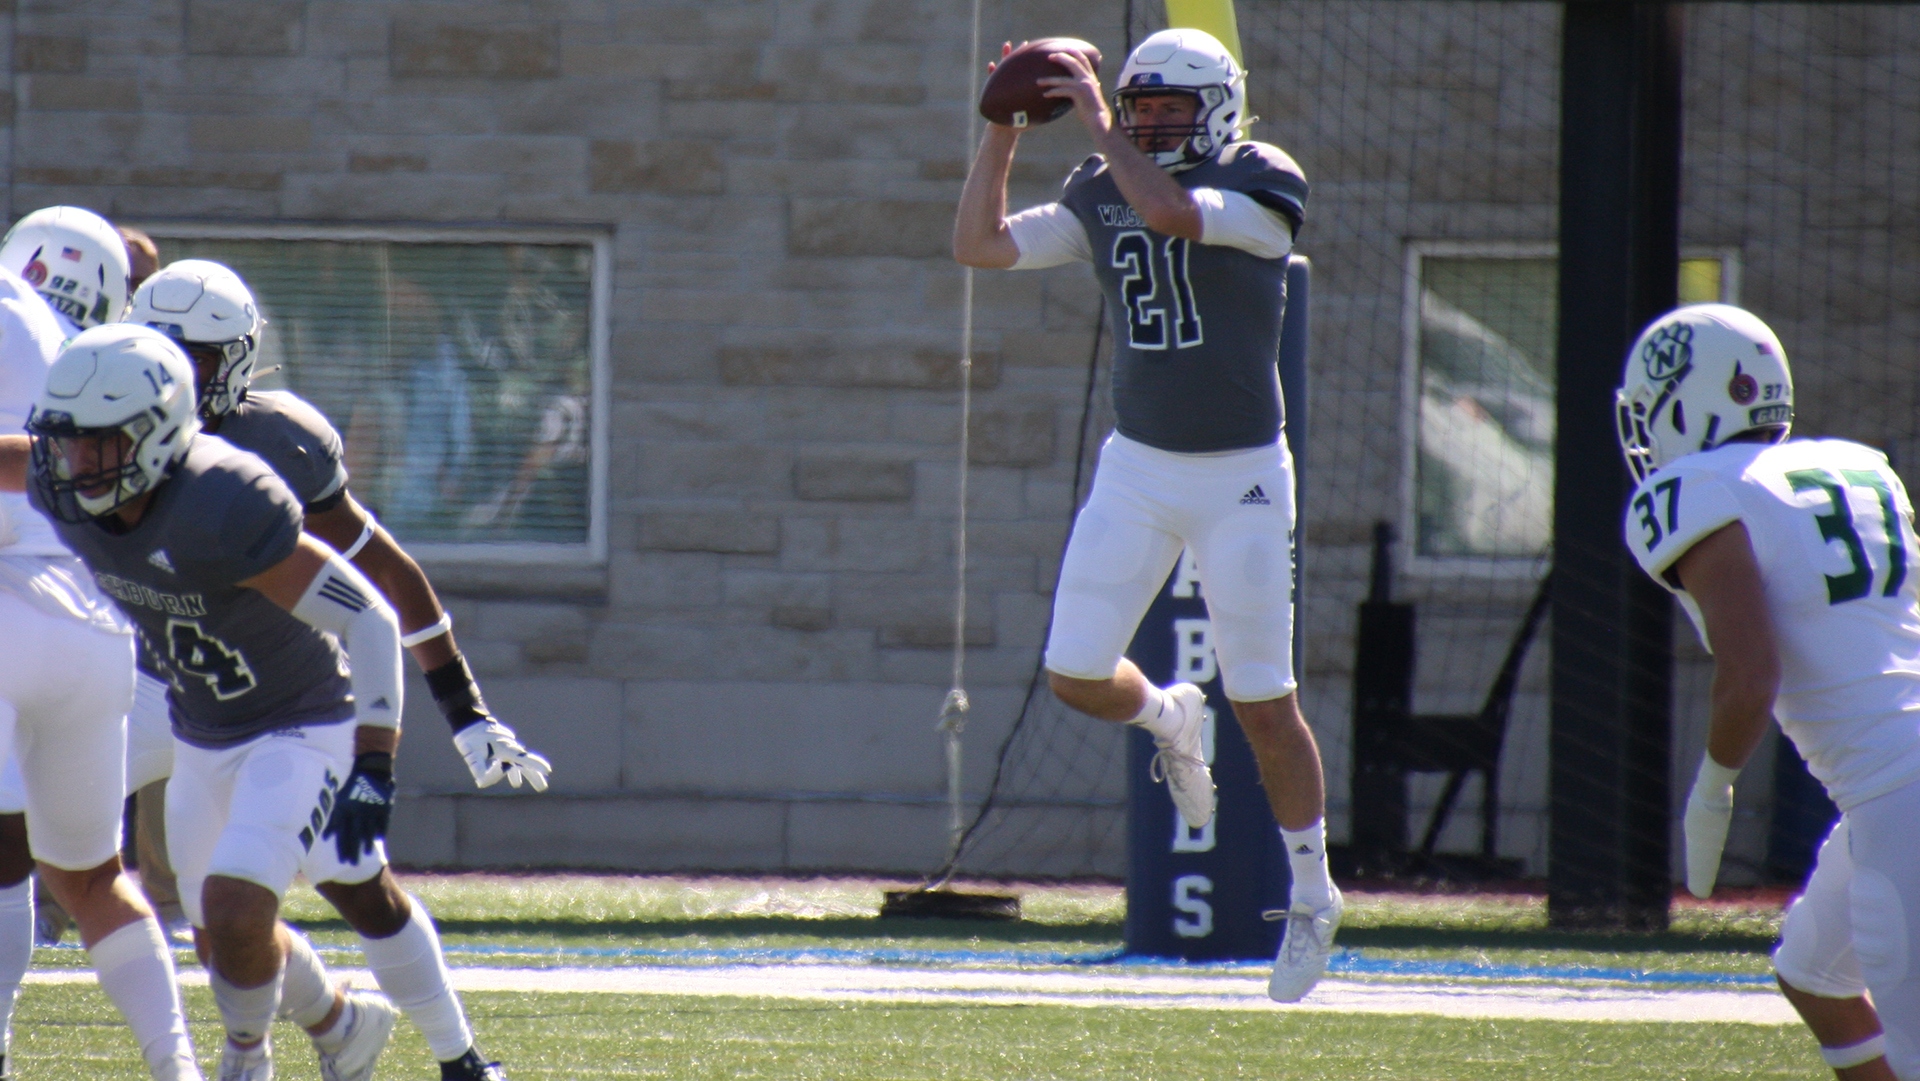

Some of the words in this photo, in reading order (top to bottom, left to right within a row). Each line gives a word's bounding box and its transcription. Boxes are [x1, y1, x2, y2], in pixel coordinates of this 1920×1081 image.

[1098, 204, 1147, 228] WAS
[49, 275, 79, 295] 92
[1112, 231, 1203, 350] 21
[143, 361, 175, 398] 14
[1763, 383, 1782, 400] 37
[1238, 497, 1271, 506] adidas
[1633, 476, 1682, 553] 37
[1785, 468, 1907, 606] 37
